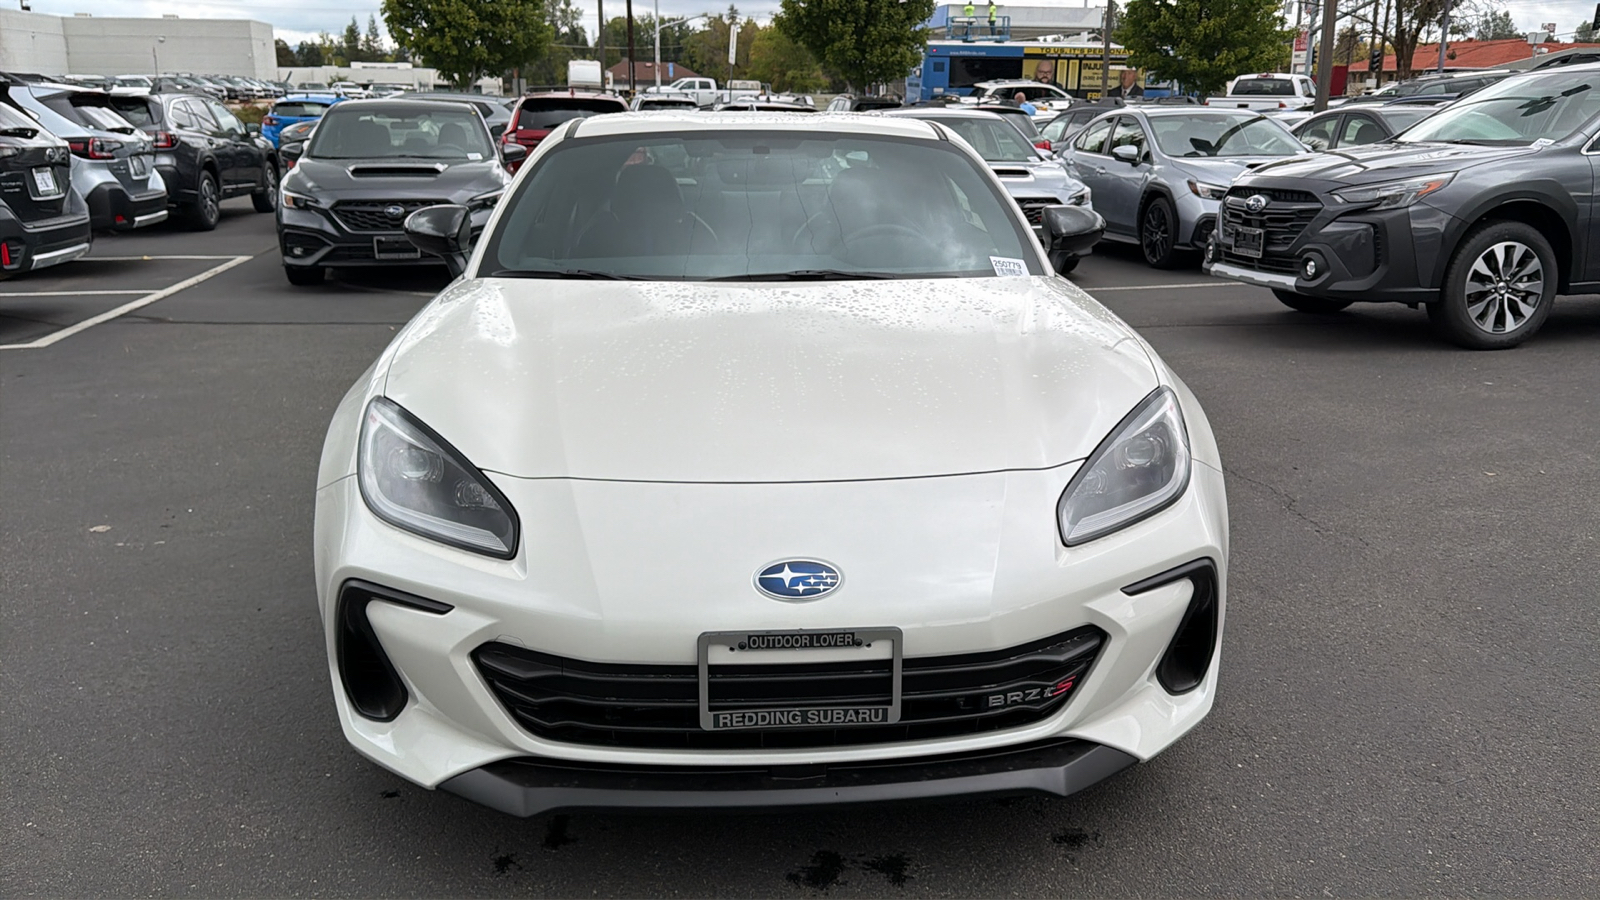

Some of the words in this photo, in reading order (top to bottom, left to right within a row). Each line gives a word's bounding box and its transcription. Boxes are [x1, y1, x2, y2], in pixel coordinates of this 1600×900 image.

[993, 260, 1021, 269] 250779
[750, 635, 809, 648] OUTDOOR
[814, 634, 853, 647] LOVER
[988, 688, 1041, 707] BRZ
[719, 711, 801, 727] REDDING
[807, 709, 883, 724] SUBARU
